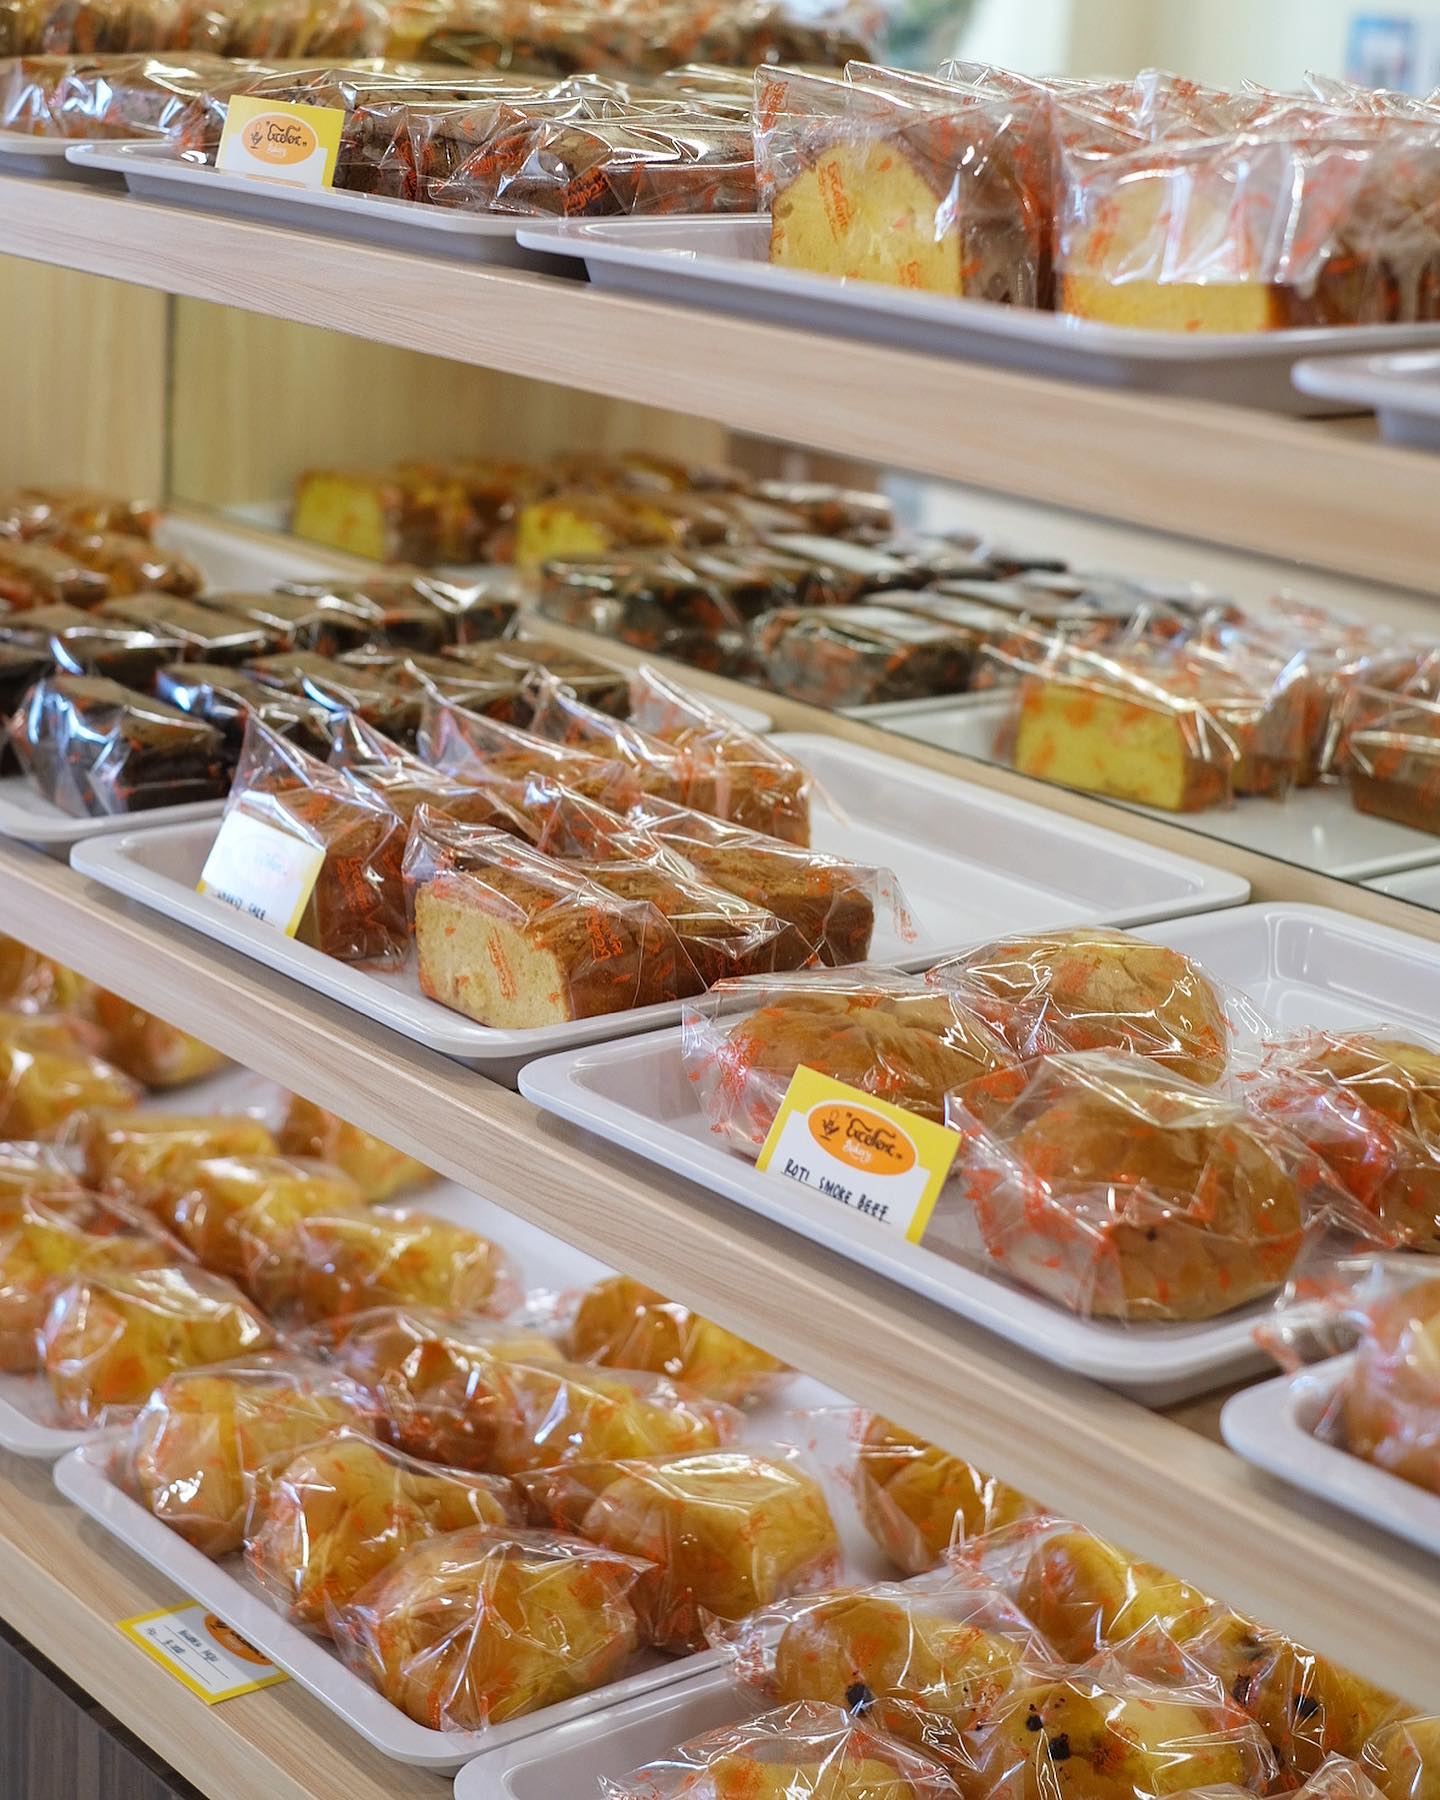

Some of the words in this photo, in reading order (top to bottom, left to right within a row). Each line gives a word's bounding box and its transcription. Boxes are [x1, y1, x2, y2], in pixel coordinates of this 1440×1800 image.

[784, 1158, 810, 1181] ROTI
[819, 1176, 853, 1204] SMOKE
[858, 1194, 889, 1222] BEEF
